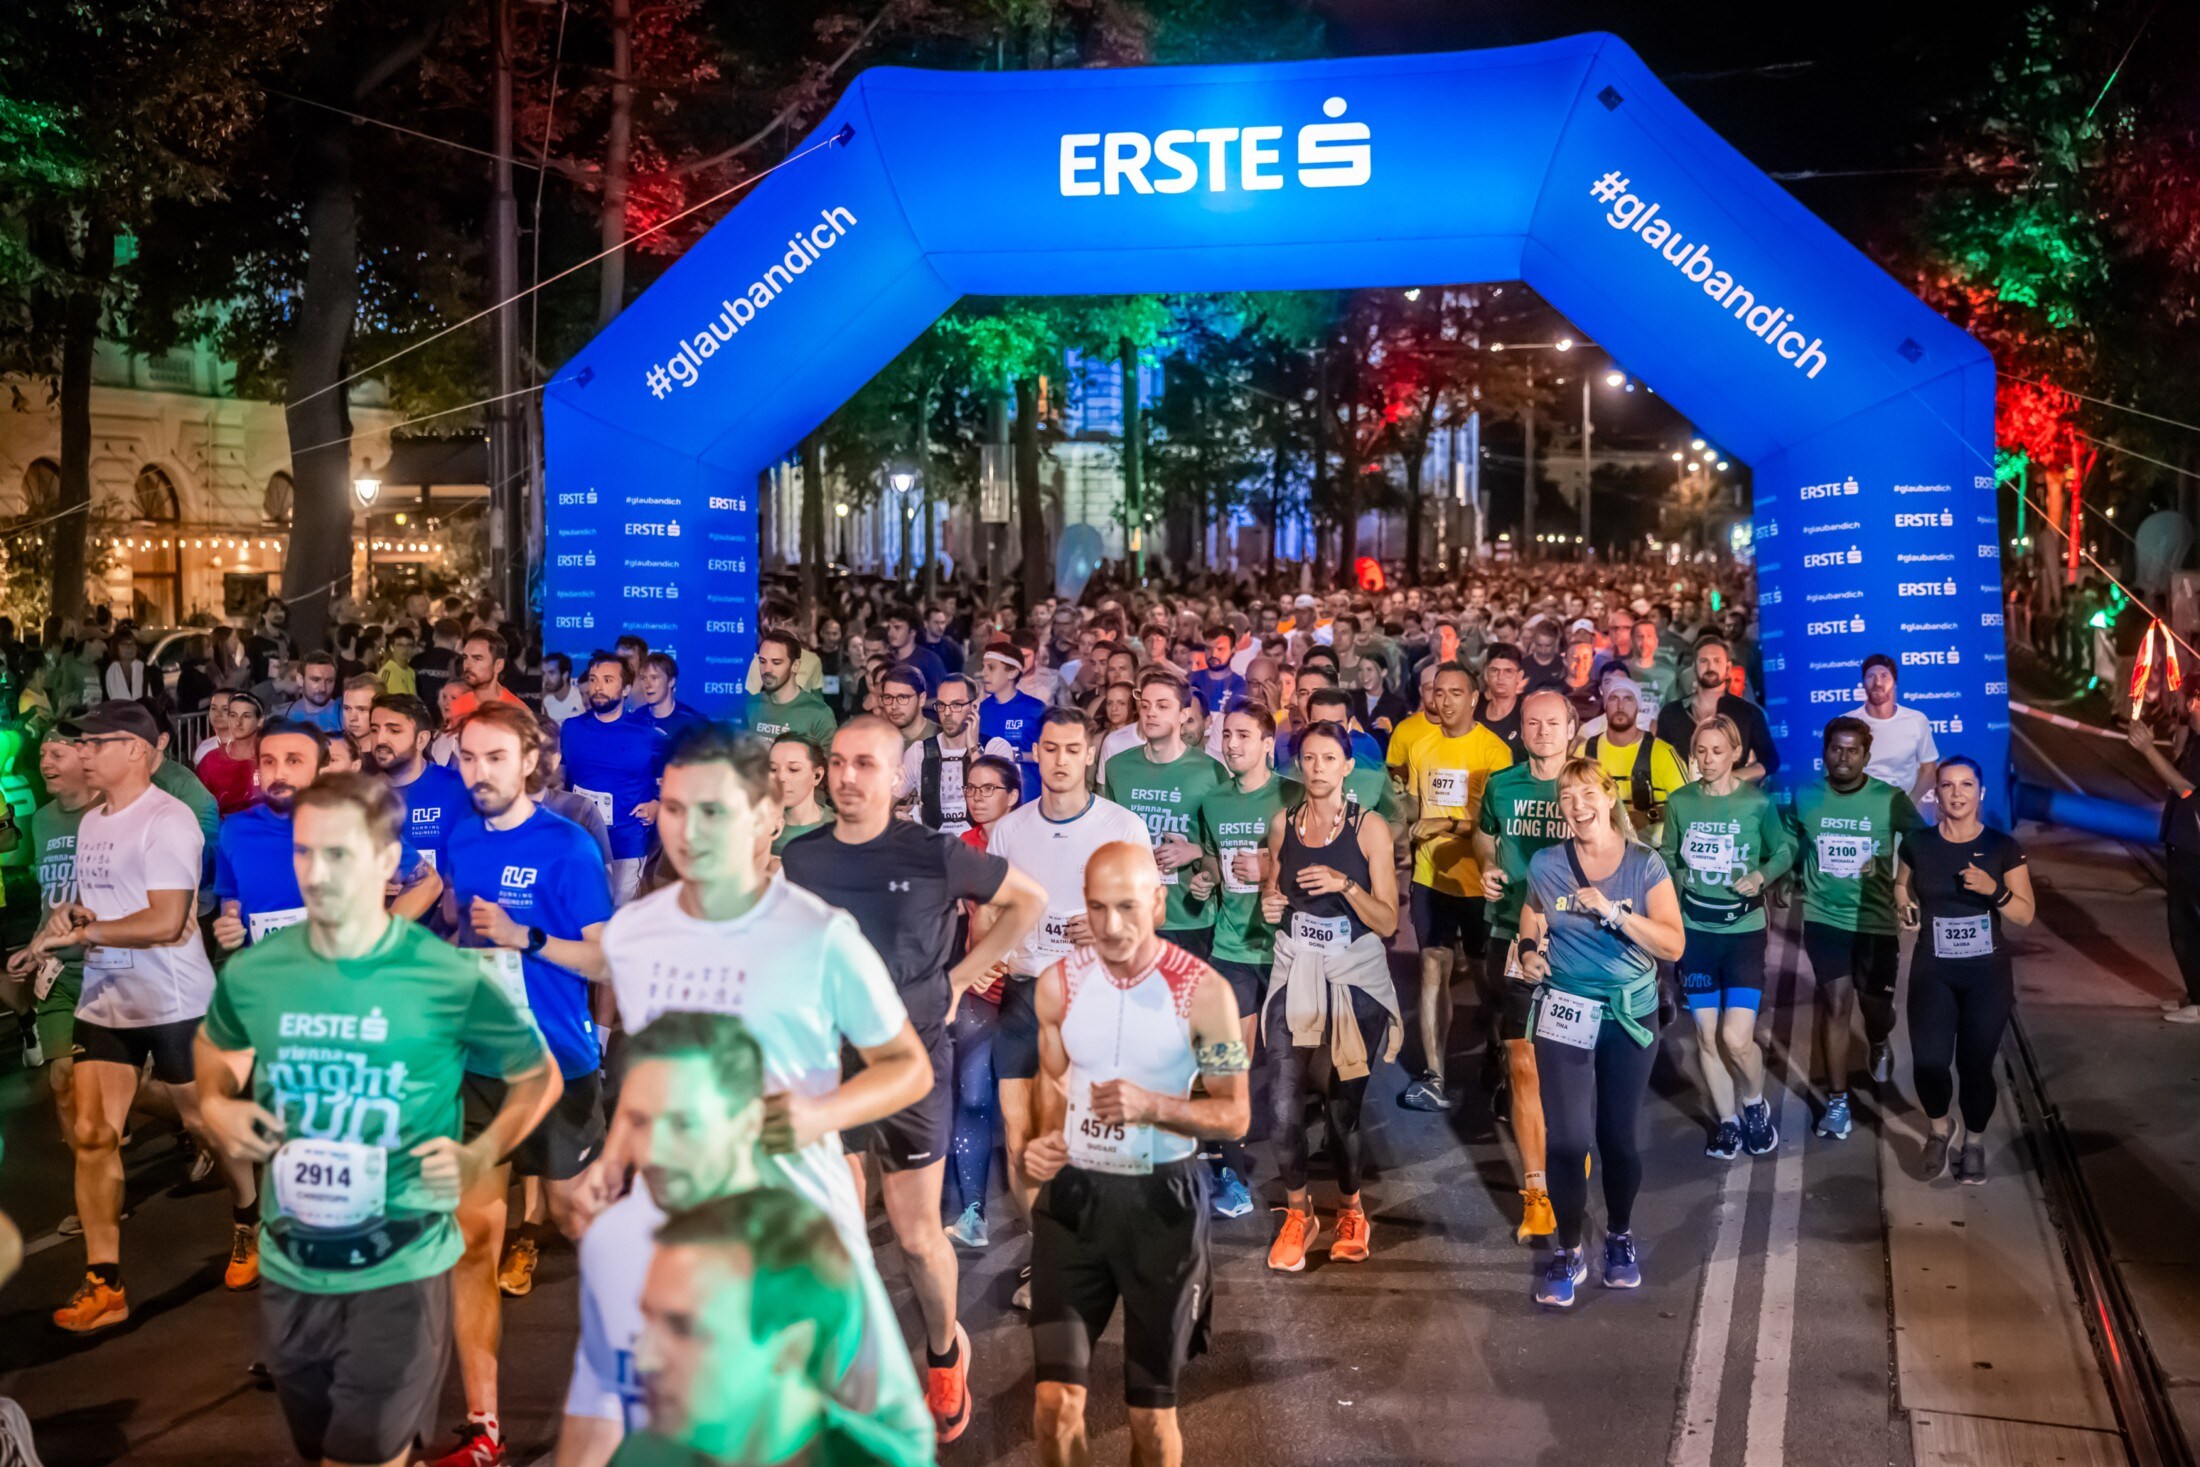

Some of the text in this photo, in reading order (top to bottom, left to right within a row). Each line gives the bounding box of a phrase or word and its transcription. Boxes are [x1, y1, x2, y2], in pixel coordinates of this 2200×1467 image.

[1060, 125, 1283, 197] ERSTE
[1589, 170, 1828, 379] #glaubandich
[644, 202, 858, 400] #glaubandich
[1800, 482, 1841, 500] ERSTE
[1894, 484, 1951, 495] #glaubandich
[559, 493, 585, 505] ERSTE
[626, 496, 682, 507] #glaubandich
[709, 497, 738, 511] ERSTE
[1894, 513, 1938, 528] ERSTE
[625, 523, 665, 537] ERSTE
[1803, 521, 1860, 535] #glaubandich
[558, 555, 583, 567] ERSTE
[624, 559, 680, 569] #glaubandich
[1804, 551, 1845, 568] ERSTE
[1897, 552, 1955, 563] #glaubandich
[708, 559, 737, 572] ERSTE
[624, 586, 663, 599] ERSTE
[1898, 582, 1942, 597] ERSTE
[1806, 590, 1863, 603] #glaubandich
[556, 617, 581, 629] ERSTE
[706, 621, 736, 633] ERSTE
[1807, 619, 1848, 636] ERSTE
[1900, 621, 1958, 632] #glaubandich
[1901, 651, 1945, 666] ERSTE
[705, 682, 734, 694] ERSTE
[1810, 688, 1851, 703] ERSTE
[756, 723, 781, 734] ERSTE
[1432, 778, 1454, 789] 4977
[1131, 788, 1169, 802] ERSTE
[1130, 804, 1162, 813] vienna
[1514, 799, 1563, 819] WEEKL
[1219, 822, 1252, 835] ERSTE
[1506, 818, 1541, 837] LONG
[1690, 822, 1726, 833] ERSTE
[1820, 817, 1857, 830] ERSTE
[46, 835, 75, 851] ERSTE
[1220, 839, 1249, 847] vienna
[1690, 842, 1719, 853] 2275
[1828, 846, 1857, 857] 2100
[1301, 925, 1333, 942] 3260
[1945, 927, 1976, 940] 3232
[1309, 941, 1325, 949] DORIS
[1550, 1004, 1582, 1023] 3261
[279, 1012, 356, 1039] ERSTE
[1555, 1021, 1568, 1030] TINA
[278, 1045, 344, 1061] vienna
[267, 1052, 408, 1104] night
[1080, 1118, 1125, 1141] 4575
[295, 1162, 352, 1188] 2914
